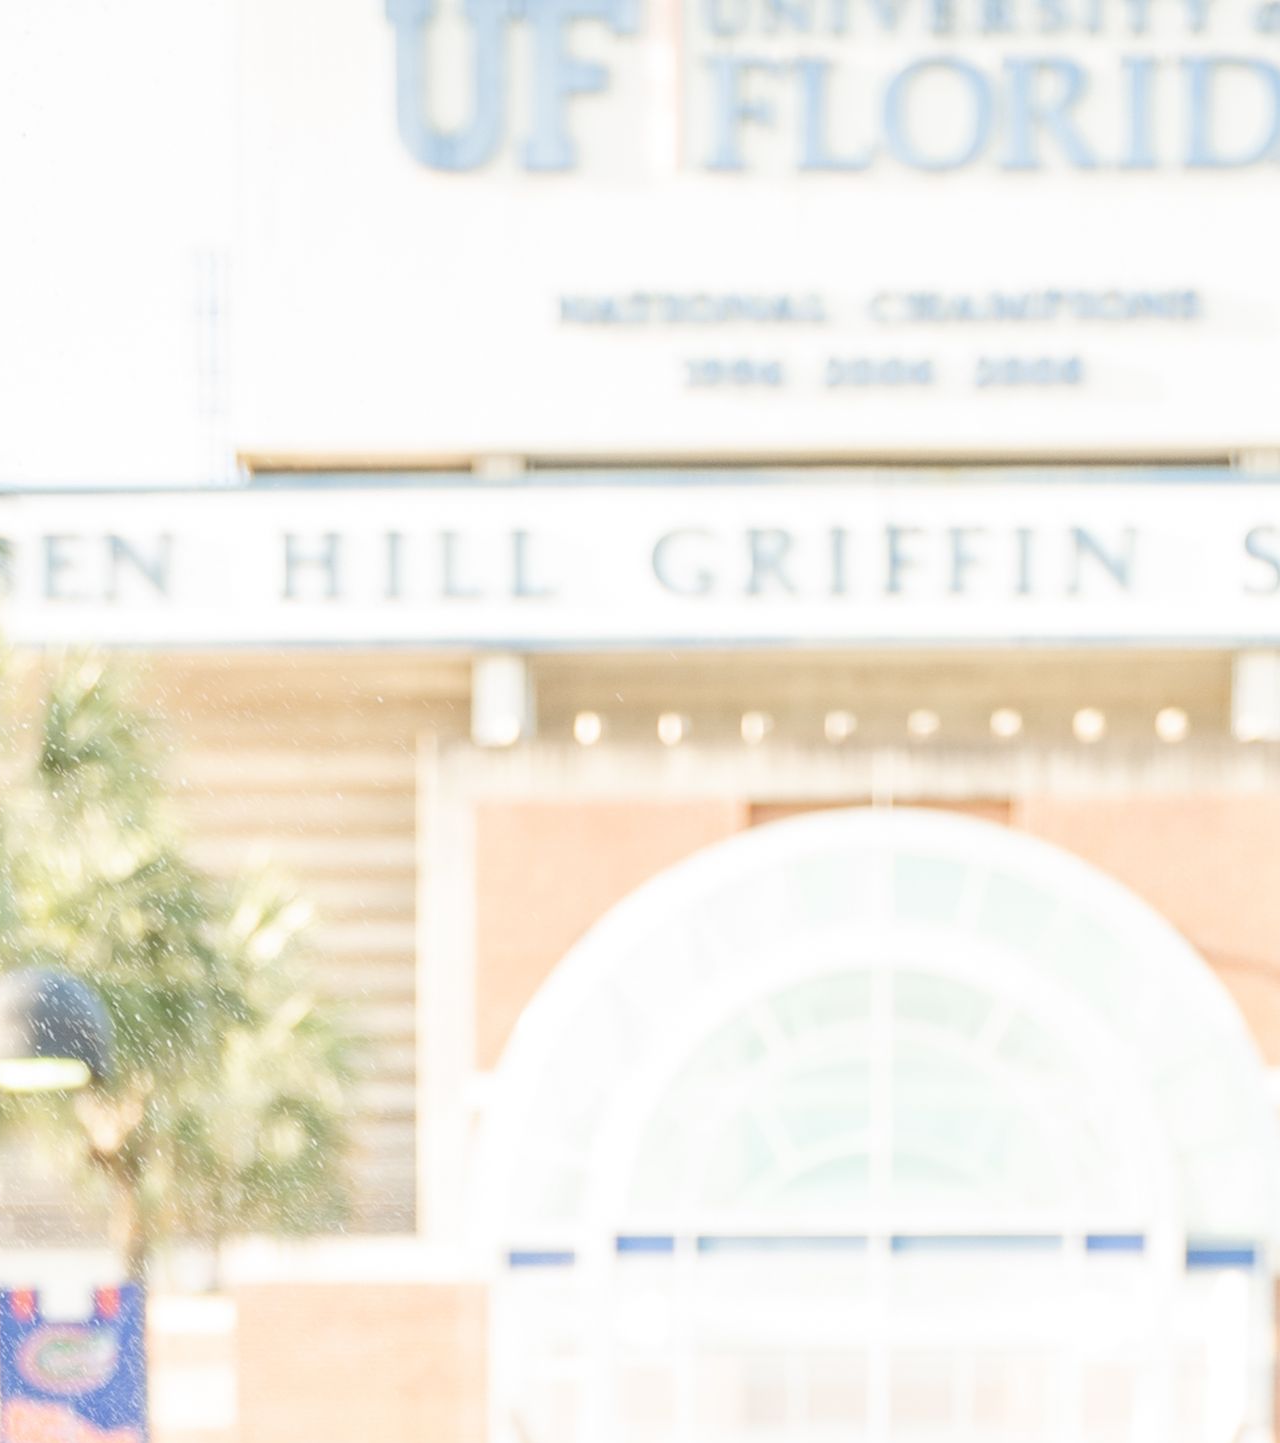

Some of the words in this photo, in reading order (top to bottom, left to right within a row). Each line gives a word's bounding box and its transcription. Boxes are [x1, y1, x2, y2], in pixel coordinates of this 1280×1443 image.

[385, 0, 639, 173] UF
[280, 528, 560, 600] HILL
[651, 524, 1138, 598] GRIFFIN
